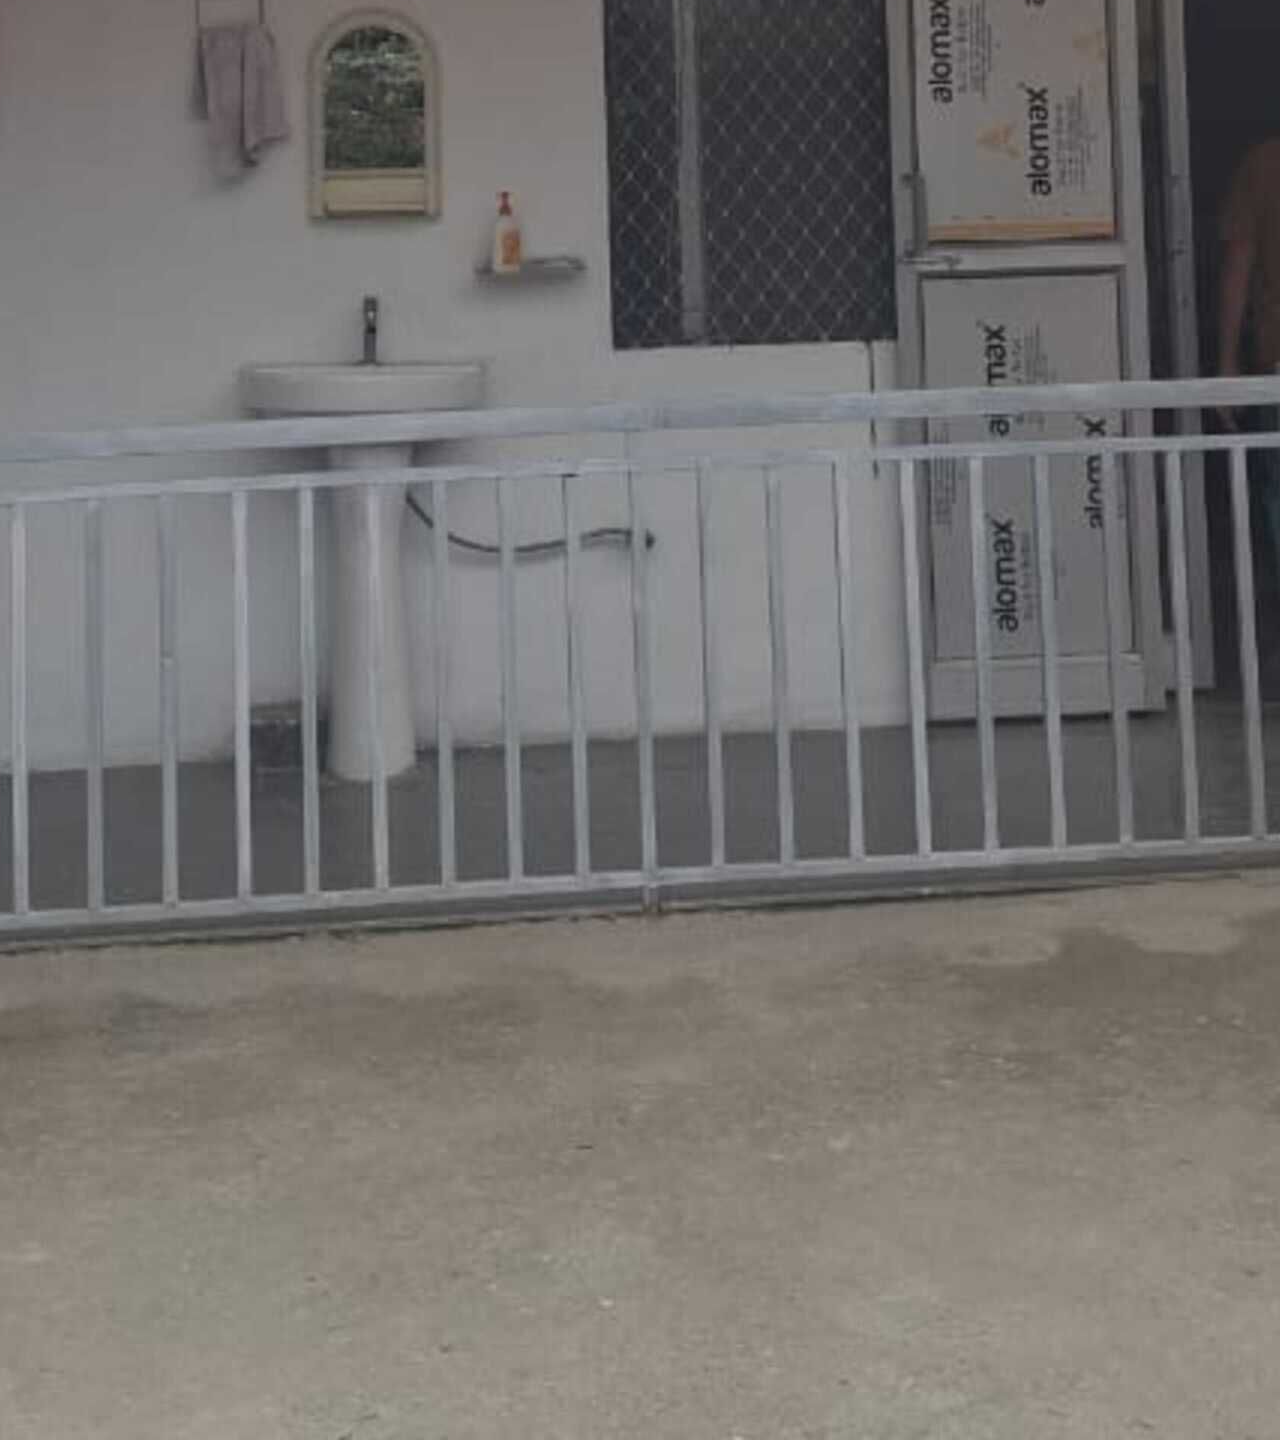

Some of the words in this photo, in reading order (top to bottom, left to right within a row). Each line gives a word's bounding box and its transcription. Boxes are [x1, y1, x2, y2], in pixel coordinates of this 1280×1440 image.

[1025, 86, 1052, 197] alomax
[983, 323, 1011, 438] almax
[993, 516, 1020, 634] alomax
